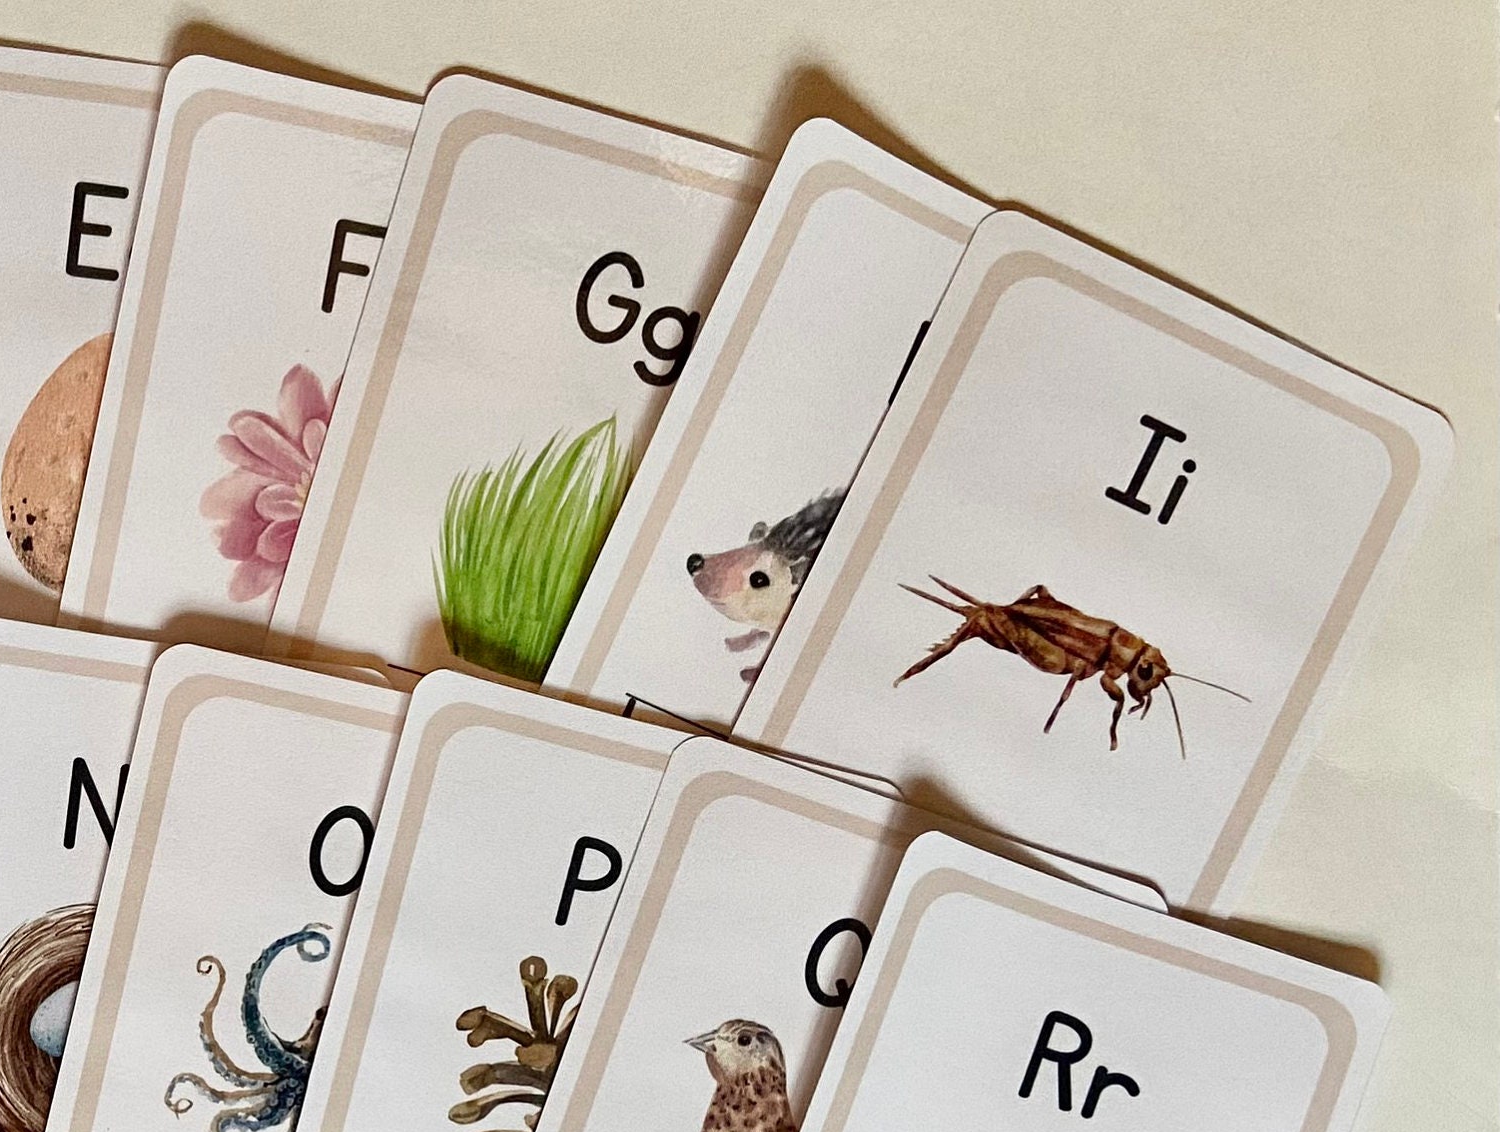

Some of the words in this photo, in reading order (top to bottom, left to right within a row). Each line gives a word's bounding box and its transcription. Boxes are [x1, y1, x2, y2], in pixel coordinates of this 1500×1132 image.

[66, 182, 129, 281] E
[575, 251, 701, 387] Gg
[1105, 415, 1196, 524] Ii
[63, 757, 129, 850] N
[309, 805, 373, 897] O
[554, 836, 623, 927] P
[804, 917, 871, 1009] Q
[1019, 1011, 1140, 1118] Rr
